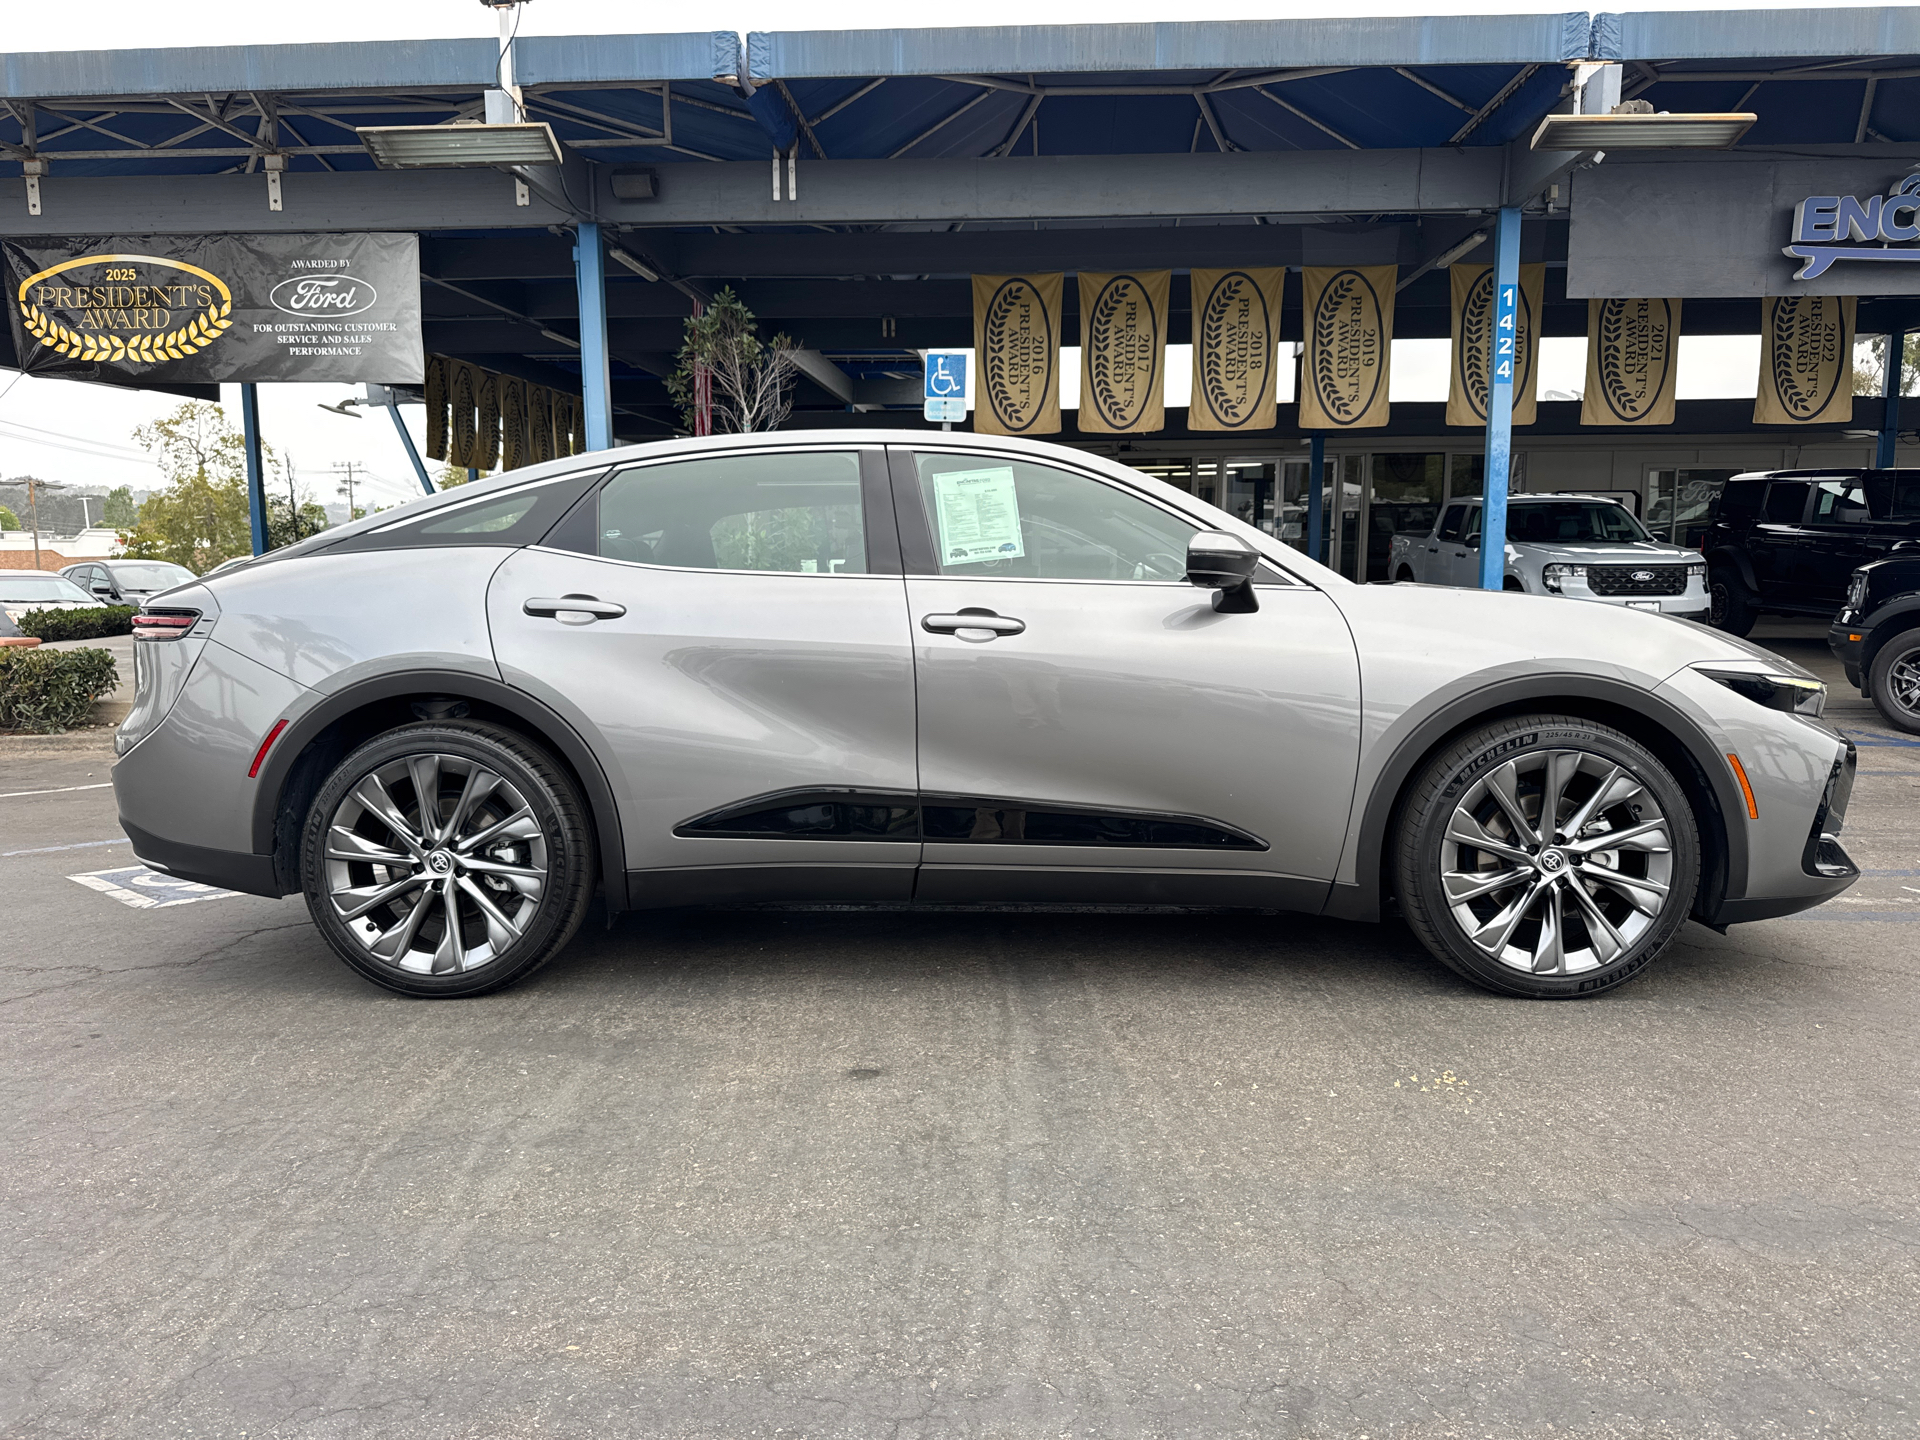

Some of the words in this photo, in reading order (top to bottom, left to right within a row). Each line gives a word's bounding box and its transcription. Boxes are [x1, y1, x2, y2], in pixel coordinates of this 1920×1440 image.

[105, 268, 137, 281] 2025
[291, 260, 337, 268] AWARDED
[340, 259, 351, 268] BY
[36, 284, 212, 308] PRESIDENT'S
[290, 280, 356, 309] Ford
[76, 308, 170, 329] AWARD
[253, 324, 273, 332] FOR
[275, 323, 342, 332] OUTSTANDING
[344, 323, 397, 331] CUSTOMER
[1496, 288, 1513, 378] 1424
[277, 335, 319, 344] SERVICE
[321, 335, 341, 344] AND
[343, 335, 372, 343] SALES
[289, 347, 362, 355] PERFORMANCE
[1008, 327, 1019, 385] AWARD
[1019, 303, 1031, 409] PRESIDENT'S
[1032, 336, 1044, 375] 2016
[1113, 325, 1125, 384] AWARD
[1124, 301, 1137, 408] PRESIDENT'S
[1137, 334, 1150, 372] 2017
[1225, 322, 1237, 381] AWARD
[1236, 297, 1250, 405] PRESIDENT'S
[1250, 331, 1263, 370] 2018
[1337, 319, 1349, 379] AWARD
[1348, 296, 1362, 402] PRESIDENT'S
[1362, 329, 1375, 367] 2019
[1624, 315, 1637, 375] AWARD
[1651, 324, 1664, 362] 2021
[1796, 313, 1810, 374] AWARD
[1821, 323, 1836, 362] 2022
[1682, 480, 1723, 501] For
[1545, 731, 1573, 739] 225/45
[1460, 734, 1533, 781] MICHELIN
[1583, 946, 1657, 991] MICHELIN
